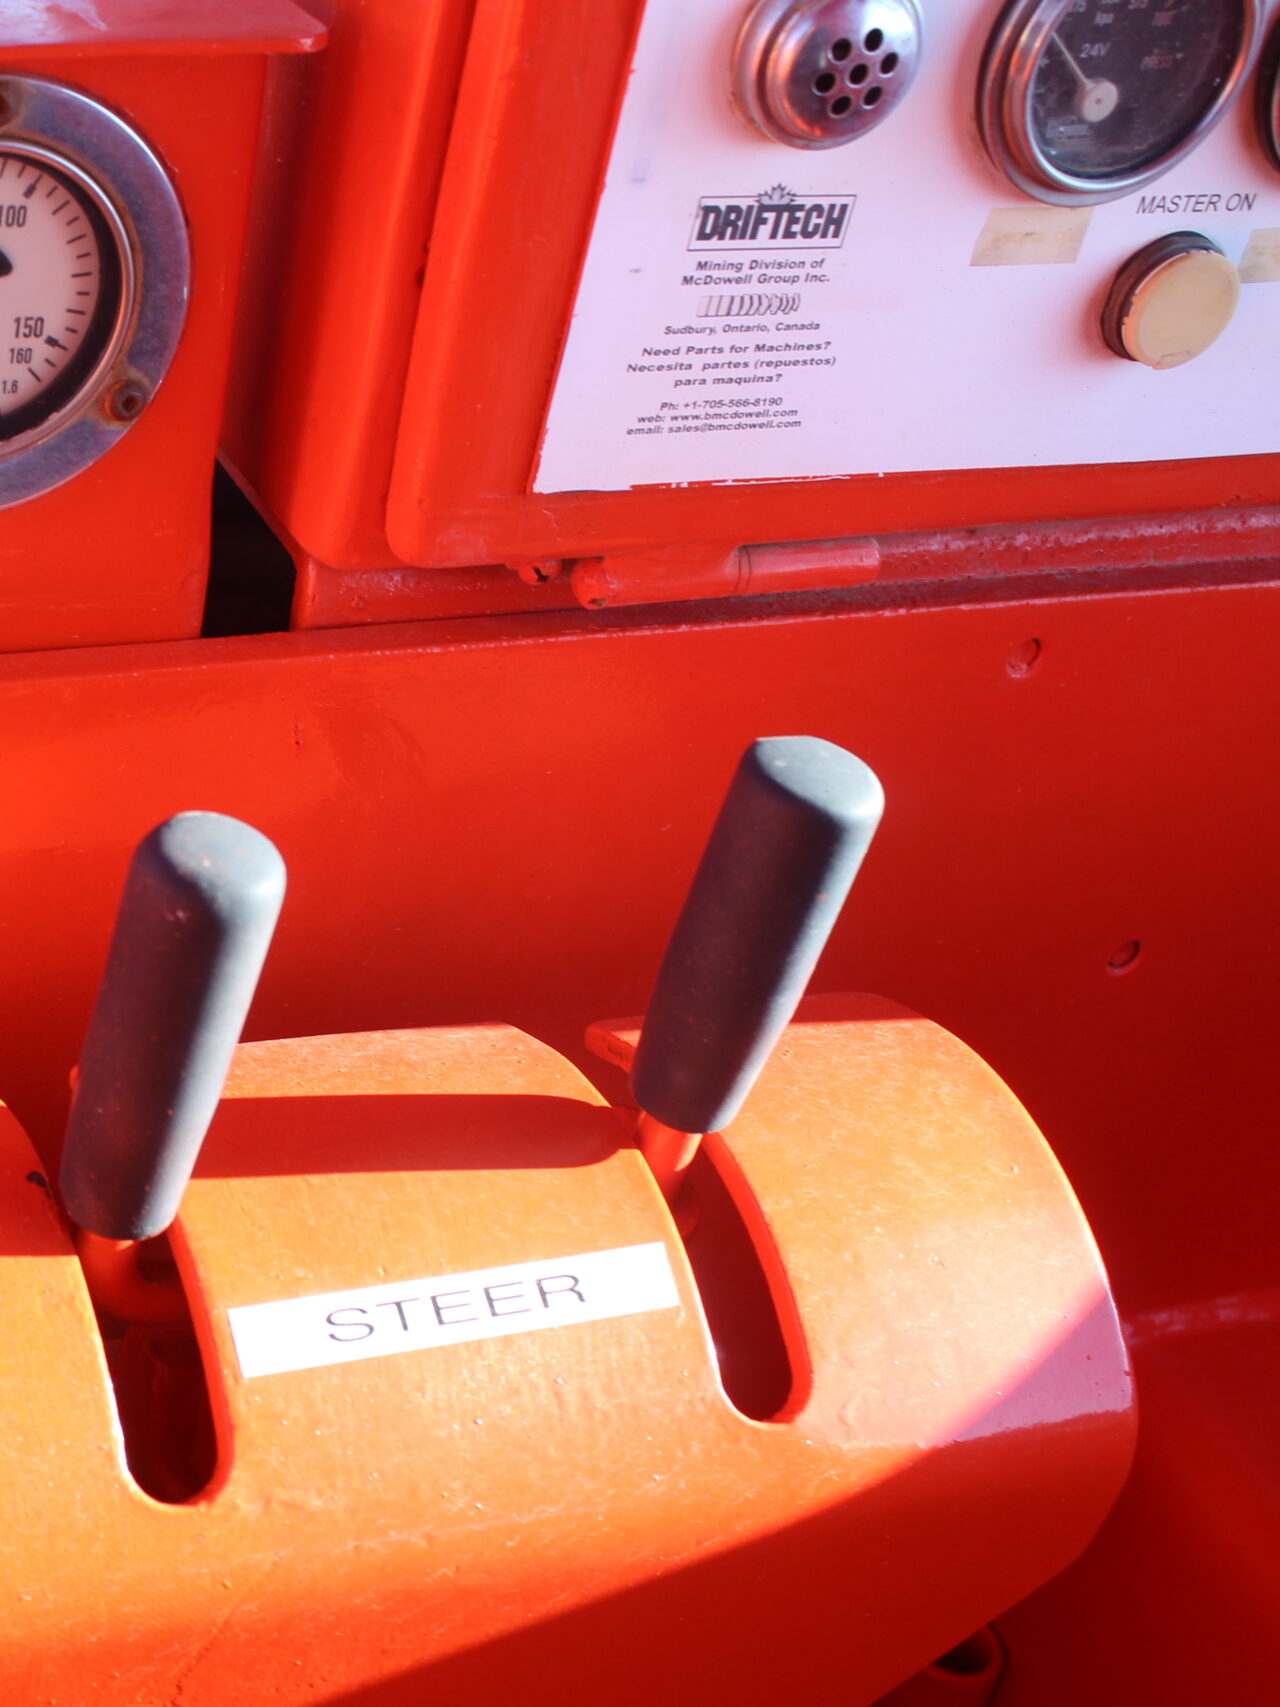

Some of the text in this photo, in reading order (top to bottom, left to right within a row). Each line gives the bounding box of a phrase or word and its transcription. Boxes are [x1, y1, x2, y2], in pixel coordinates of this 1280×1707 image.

[1080, 42, 1111, 58] 24V
[1136, 193, 1258, 214] MASTER ON
[696, 203, 849, 241] DRIFTECH
[696, 258, 826, 273] Mining Division of
[681, 272, 830, 286] McDowell Group Inc.
[13, 317, 44, 338] 150
[664, 321, 821, 336] Sudbury, Ontario, Canada
[9, 347, 33, 364] 160
[641, 341, 832, 357] Need Parts for Machines?
[626, 356, 836, 373] Necesita partes (repuestos)
[1, 380, 18, 395] 1.6
[673, 373, 783, 388] para maquina?
[660, 402, 679, 411] Ph:
[637, 408, 798, 424] web: www.bmcdowell.com
[626, 420, 801, 436] email: sales@bmcdowell.com
[325, 1273, 586, 1342] STEER
